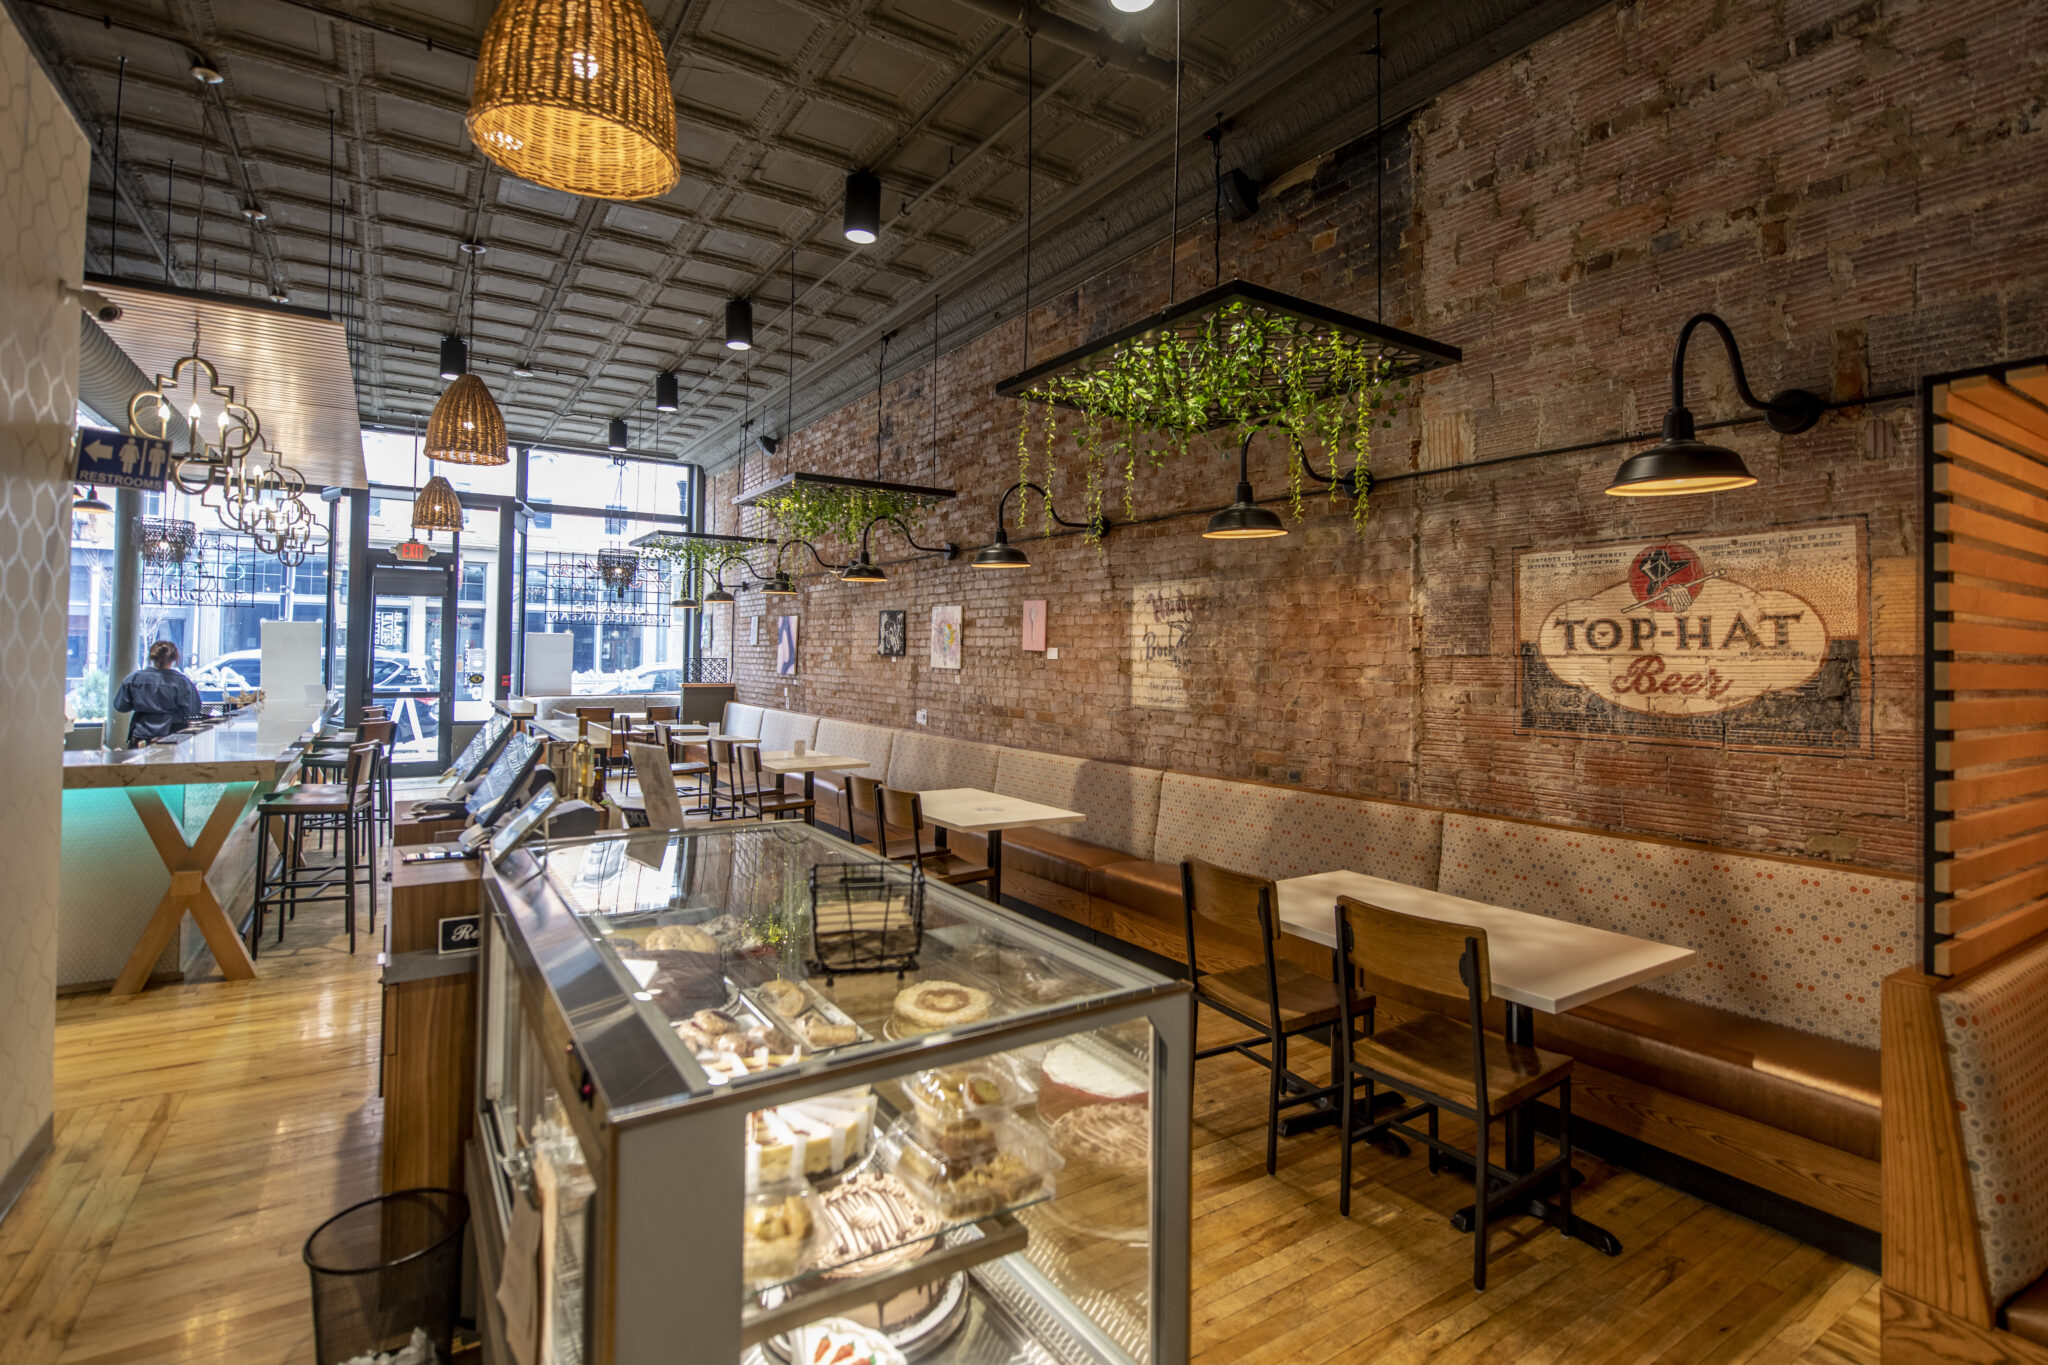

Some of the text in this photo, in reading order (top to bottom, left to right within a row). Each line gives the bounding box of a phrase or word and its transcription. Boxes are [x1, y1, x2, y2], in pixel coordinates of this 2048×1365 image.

[79, 470, 162, 490] RESTROOMS
[402, 543, 424, 559] EXIT
[382, 612, 392, 645] LIVES
[394, 612, 403, 646] BLACK
[1553, 610, 1805, 651] TOP-HAT
[1611, 655, 1735, 696] Beer
